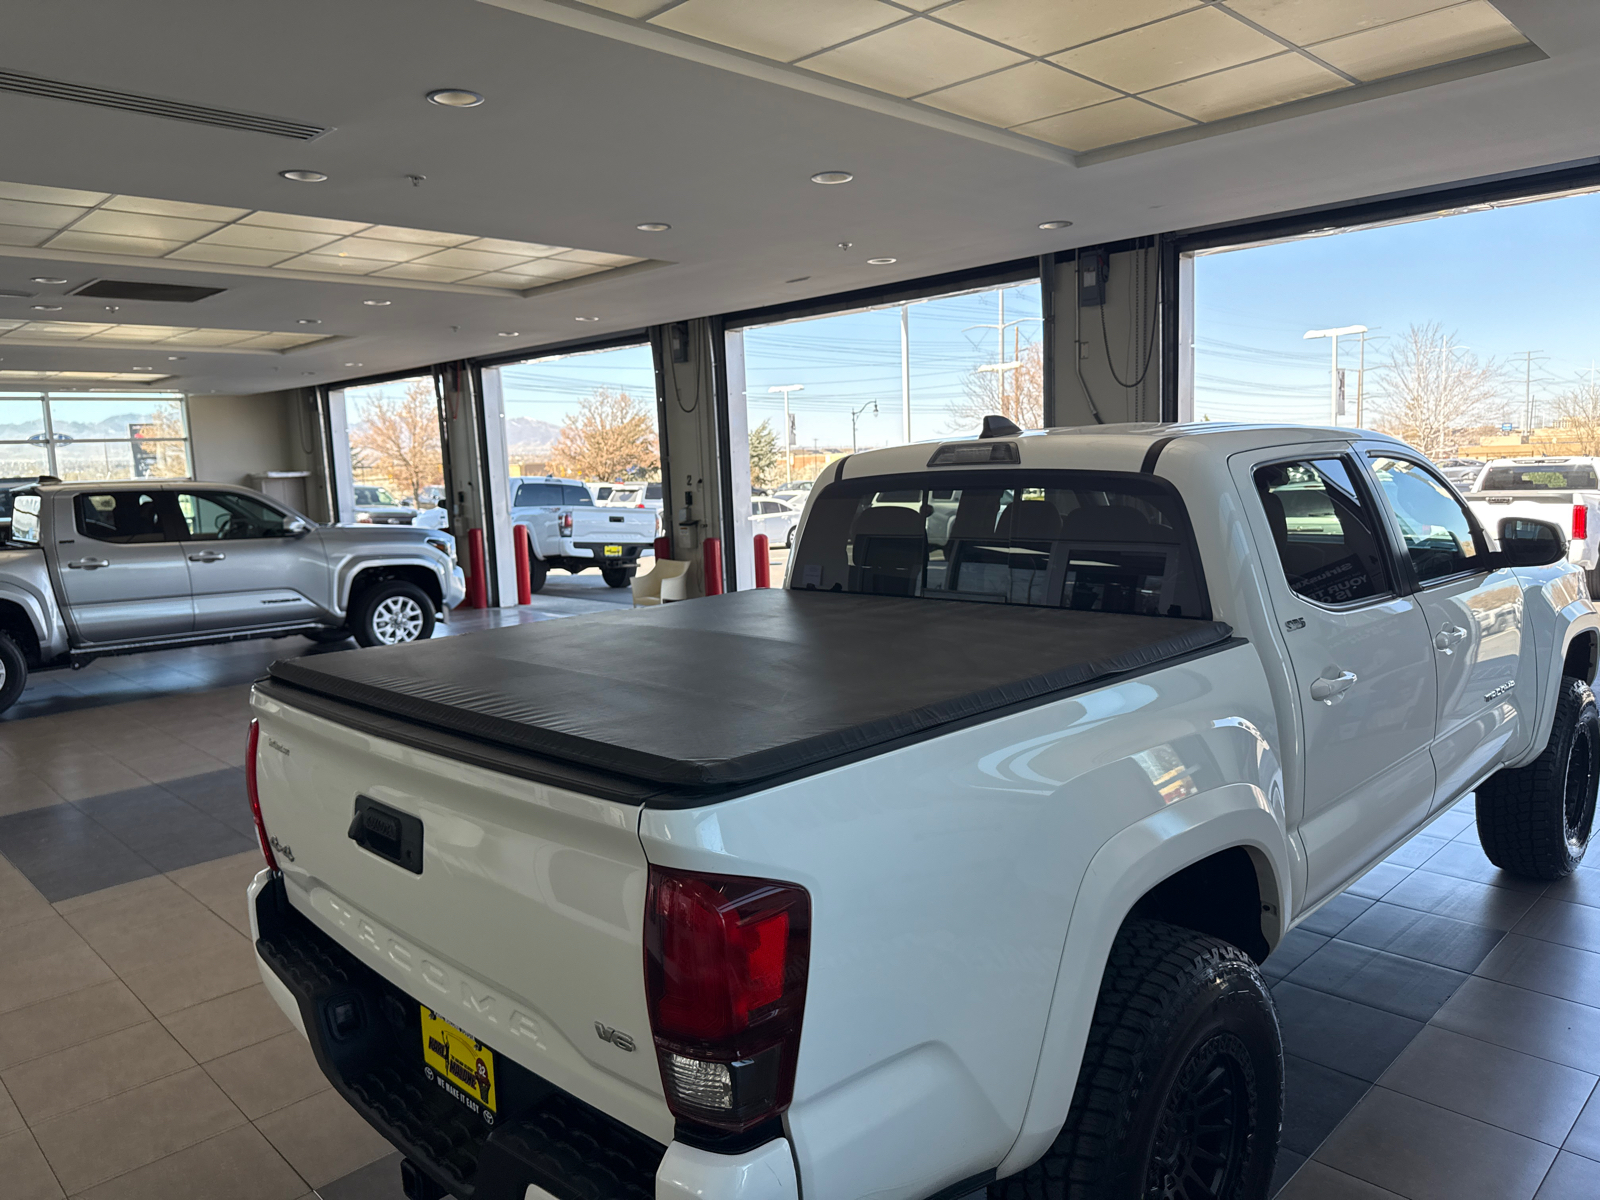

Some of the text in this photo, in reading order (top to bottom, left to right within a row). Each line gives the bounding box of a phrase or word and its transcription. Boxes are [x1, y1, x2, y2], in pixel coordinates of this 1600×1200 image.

[687, 475, 692, 486] 2
[328, 897, 548, 1051] TACOMA
[594, 1020, 636, 1052] V6
[436, 1075, 480, 1114] WE MAKE IT EASY
